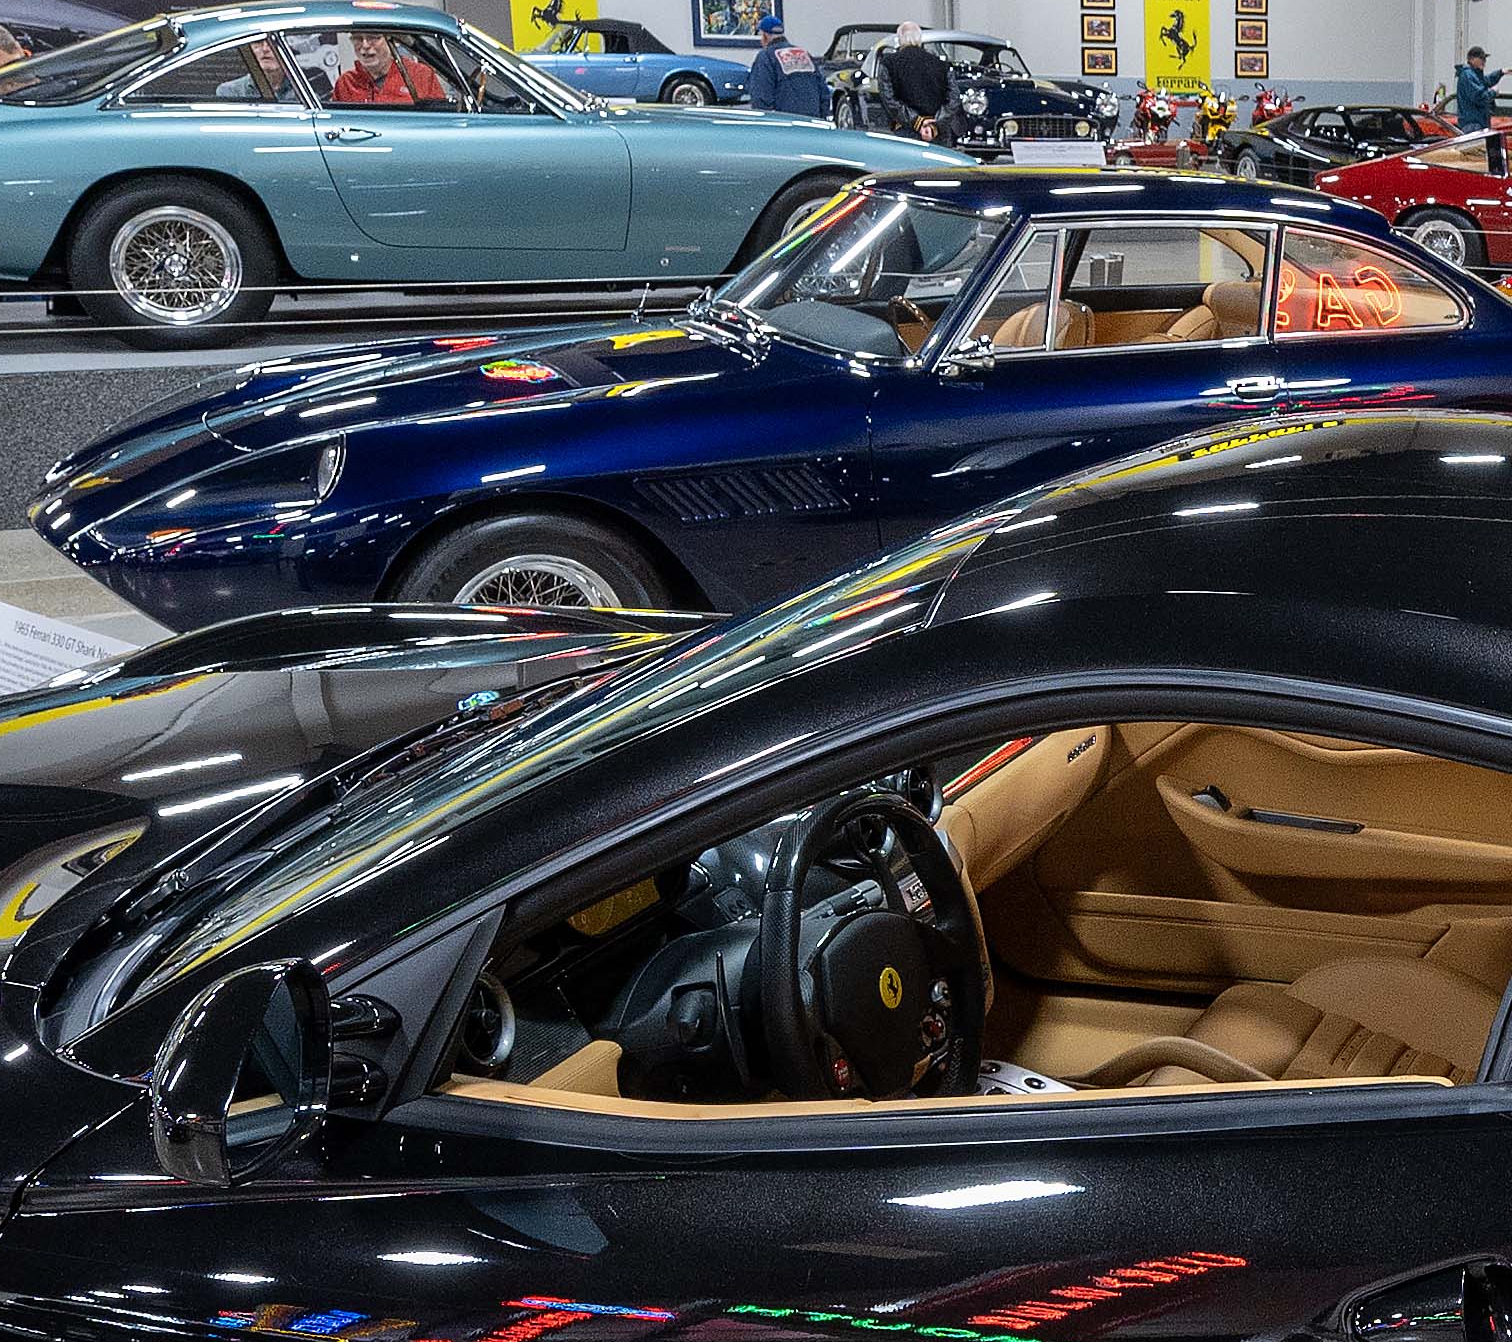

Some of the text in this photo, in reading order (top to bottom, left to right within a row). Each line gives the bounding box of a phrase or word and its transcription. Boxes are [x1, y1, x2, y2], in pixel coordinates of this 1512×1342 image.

[29, 625, 51, 642] Ferrari
[65, 637, 76, 651] GT
[76, 640, 97, 657] Shark
